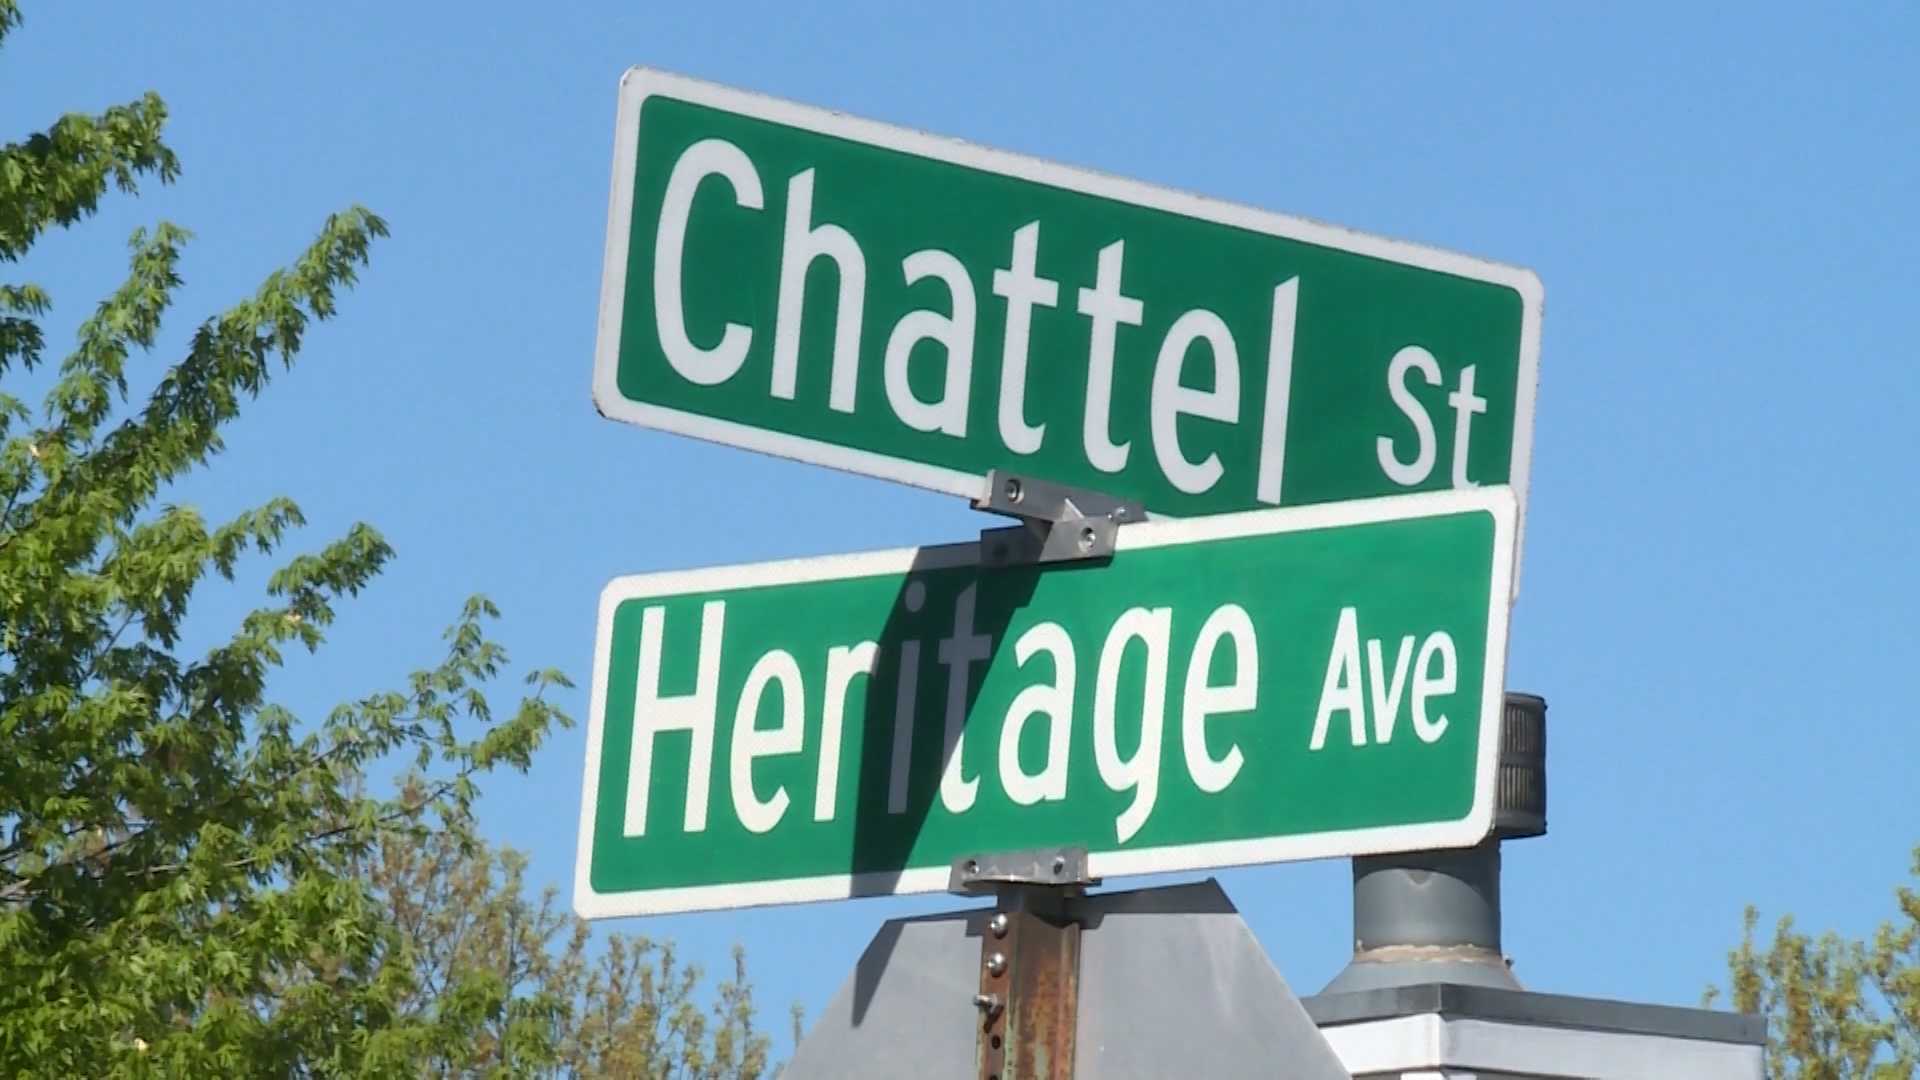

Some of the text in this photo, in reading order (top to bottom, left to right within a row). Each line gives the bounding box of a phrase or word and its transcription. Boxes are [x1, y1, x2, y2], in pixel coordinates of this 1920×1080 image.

[654, 138, 1488, 504] Chattel St
[623, 581, 1458, 843] Heritage Ave
